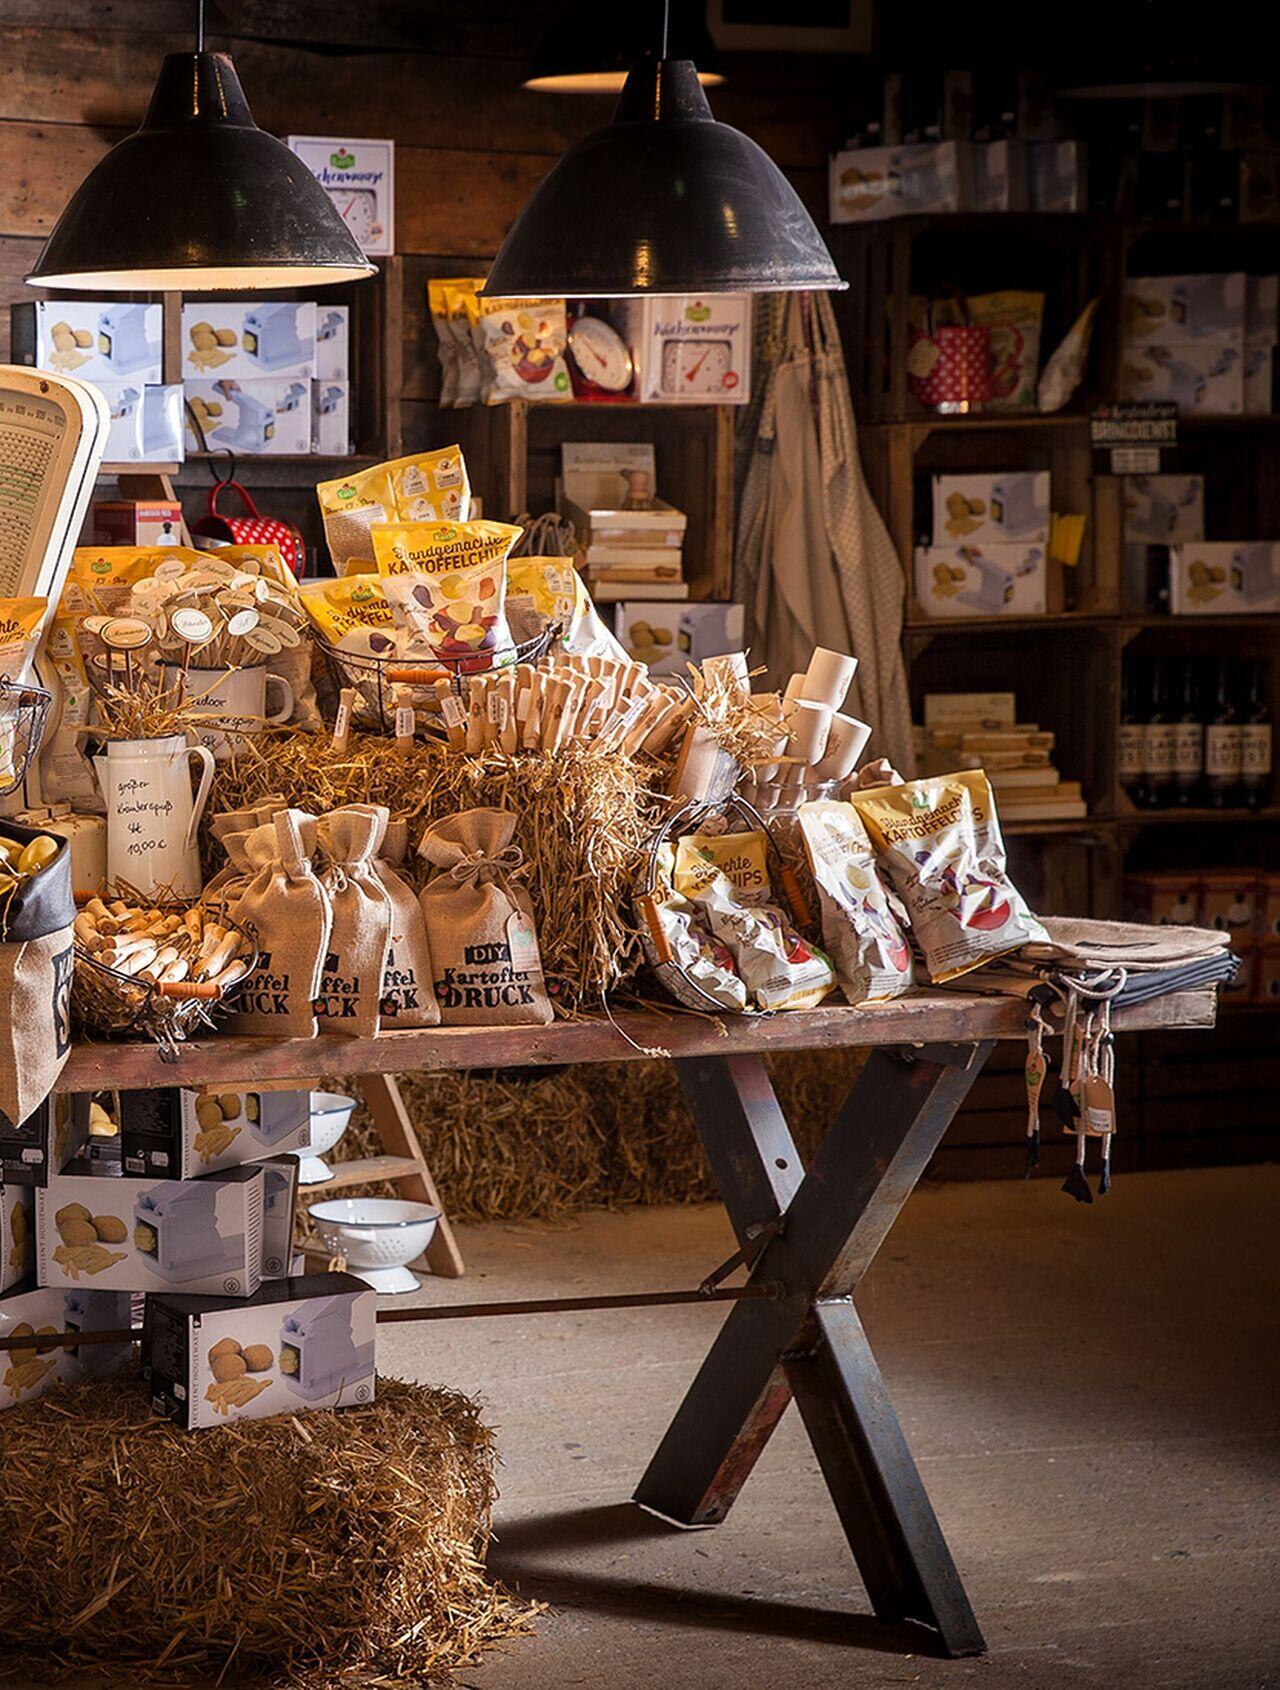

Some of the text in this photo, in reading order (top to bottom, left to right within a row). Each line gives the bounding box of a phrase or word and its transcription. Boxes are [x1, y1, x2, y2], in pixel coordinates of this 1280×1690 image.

[473, 945, 505, 962] DIY
[444, 967, 531, 985] Kartoffel
[442, 984, 536, 1009] DRUCK
[39, 1243, 47, 1284] EXCELLENT
[192, 1384, 200, 1426] EXCELLENT
